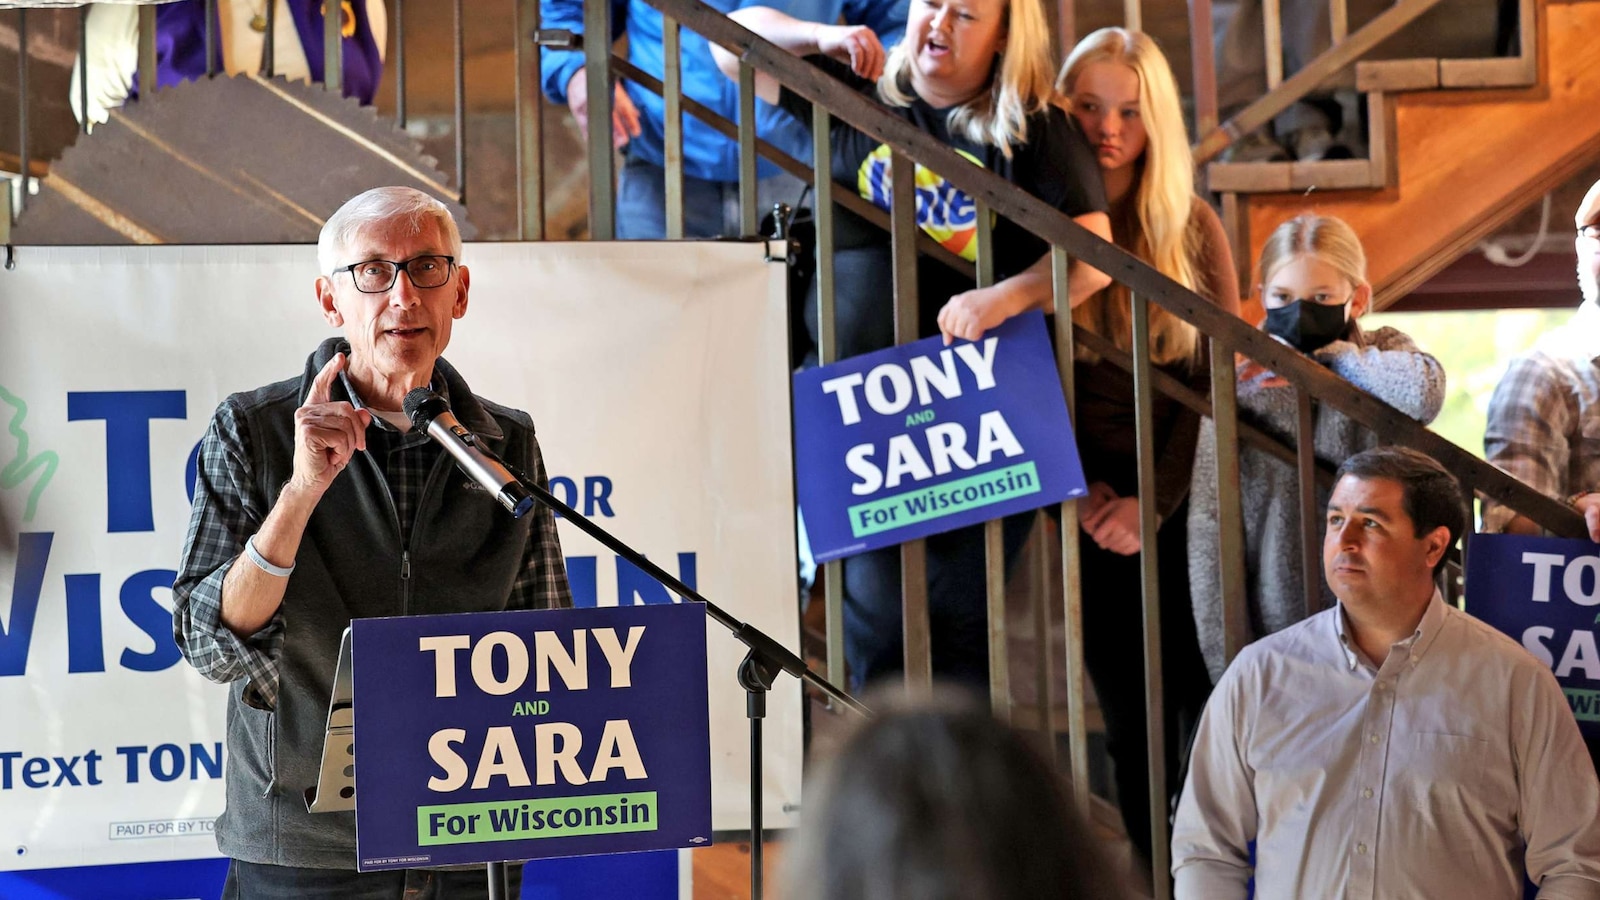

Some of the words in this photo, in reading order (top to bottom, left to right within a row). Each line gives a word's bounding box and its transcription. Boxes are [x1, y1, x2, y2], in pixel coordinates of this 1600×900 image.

[821, 337, 998, 426] TONY
[905, 409, 935, 428] AND
[845, 410, 1025, 496] SARA
[858, 506, 898, 529] For
[903, 471, 1032, 517] Wisconsin
[419, 626, 647, 698] TONY
[512, 700, 550, 717] AND
[0, 749, 103, 790] Text
[116, 742, 223, 784] TON
[427, 719, 648, 792] SARA
[116, 825, 145, 836] PAID
[148, 822, 174, 834] FOR
[178, 821, 196, 833] BY
[429, 813, 481, 837] For
[489, 798, 650, 832] Wisconsin
